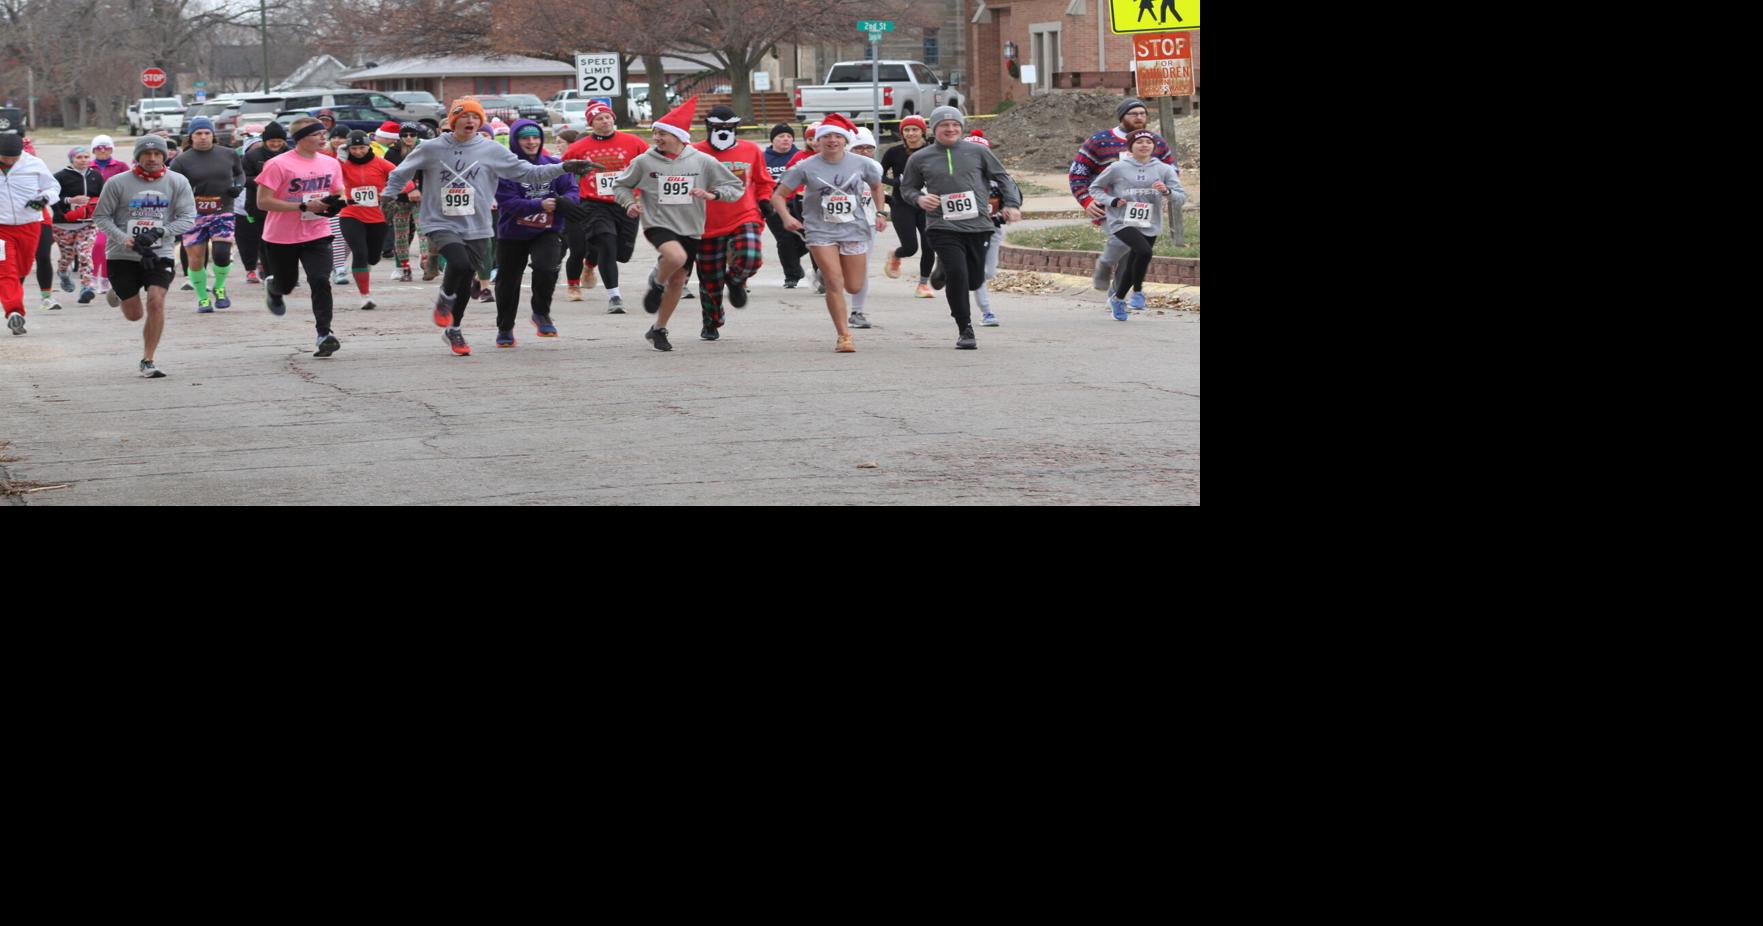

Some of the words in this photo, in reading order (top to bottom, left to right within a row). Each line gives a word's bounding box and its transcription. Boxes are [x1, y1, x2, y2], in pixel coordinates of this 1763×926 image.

[1137, 37, 1186, 57] STOP
[580, 58, 616, 66] SPEED
[584, 66, 612, 75] LIMIT
[143, 73, 164, 82] STOP
[583, 75, 615, 92] 20
[287, 174, 333, 193] STATE
[600, 176, 619, 189] 97
[663, 182, 689, 195] 995
[354, 190, 375, 202] 970
[445, 193, 470, 207] 999
[827, 201, 852, 215] 993
[946, 198, 972, 213] 969
[1129, 207, 1150, 220] 991
